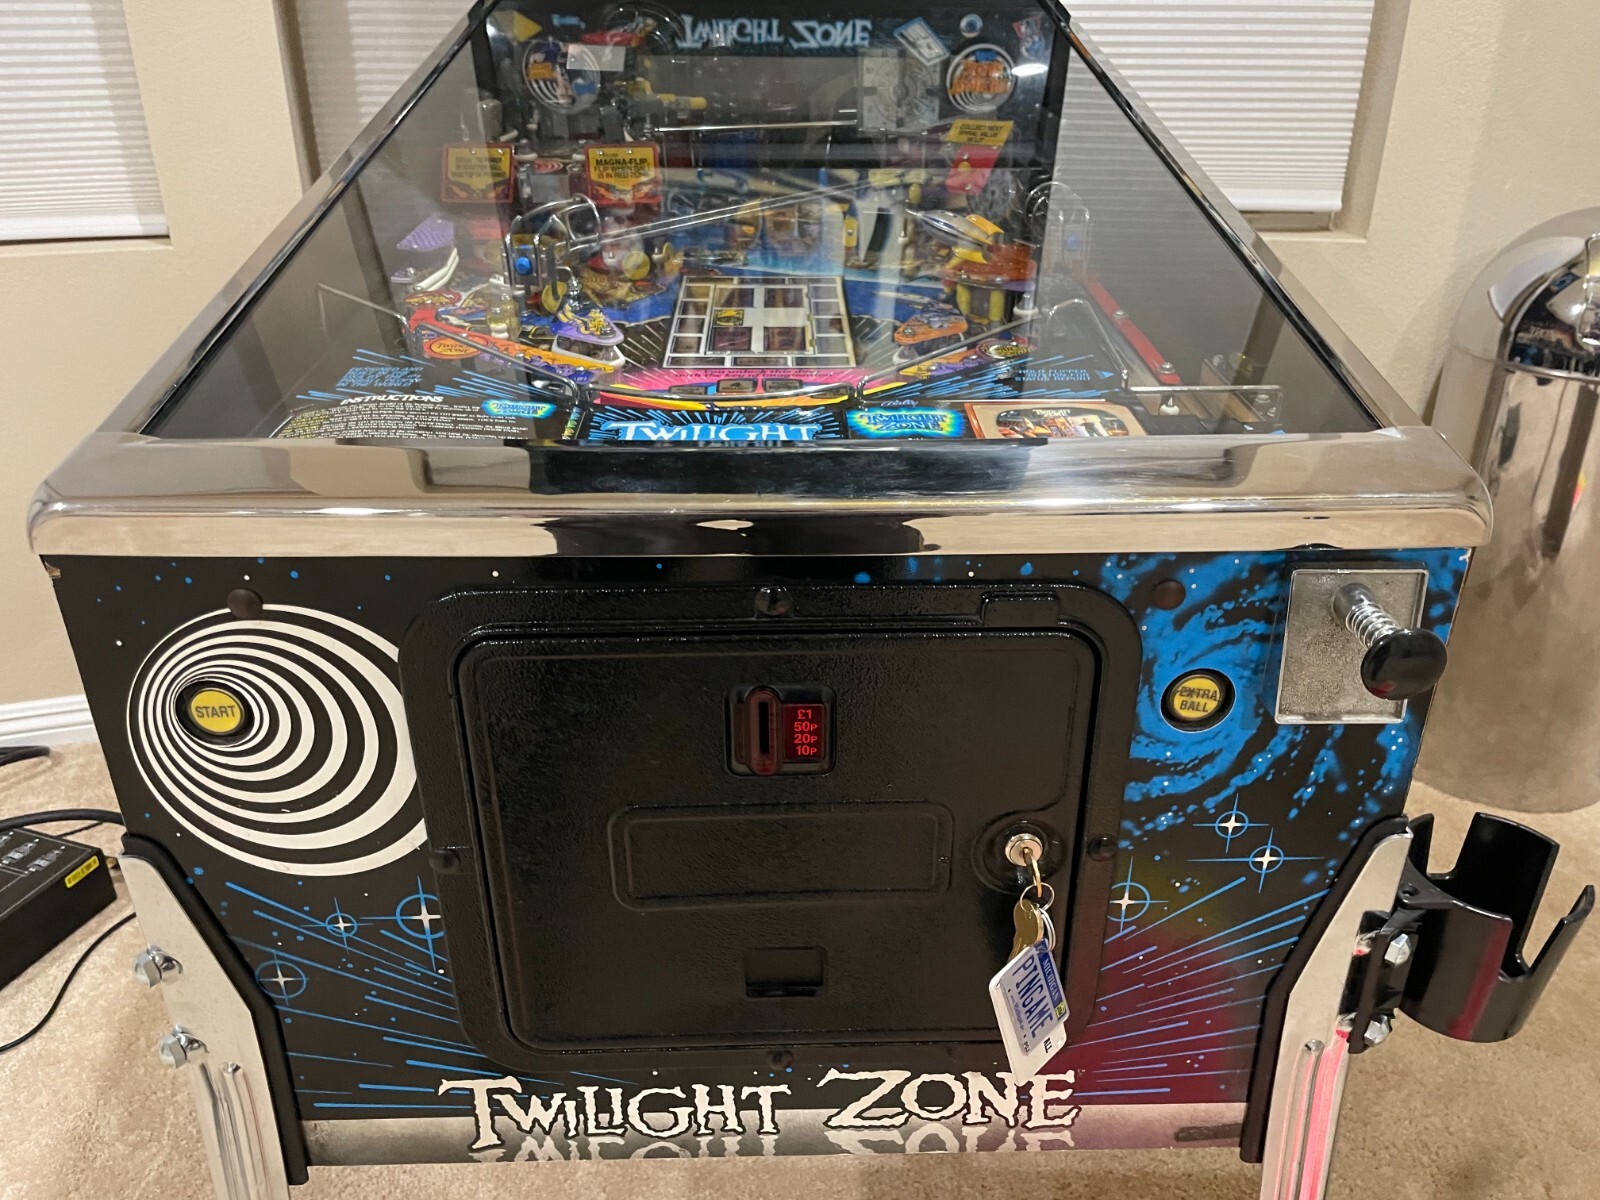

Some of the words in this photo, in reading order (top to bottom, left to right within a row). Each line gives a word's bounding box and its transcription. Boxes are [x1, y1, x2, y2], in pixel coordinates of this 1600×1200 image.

[596, 158, 648, 166] MAGNA-FLIP
[340, 394, 444, 406] INSTRUCTIONS
[861, 413, 947, 424] TWILIGHT
[877, 421, 944, 431] ZONE
[608, 420, 819, 441] TWILIGHT
[1178, 686, 1219, 702] EXTRA
[195, 705, 236, 719] START
[797, 709, 812, 719] £1
[1180, 700, 1209, 713] BALL
[1042, 957, 1060, 1001] MICHIGAN
[1012, 954, 1054, 1038] PINGAME
[1043, 1037, 1053, 1053] ALL
[816, 1067, 1081, 1129] ZONE
[438, 1076, 792, 1149] TWILIGHT
